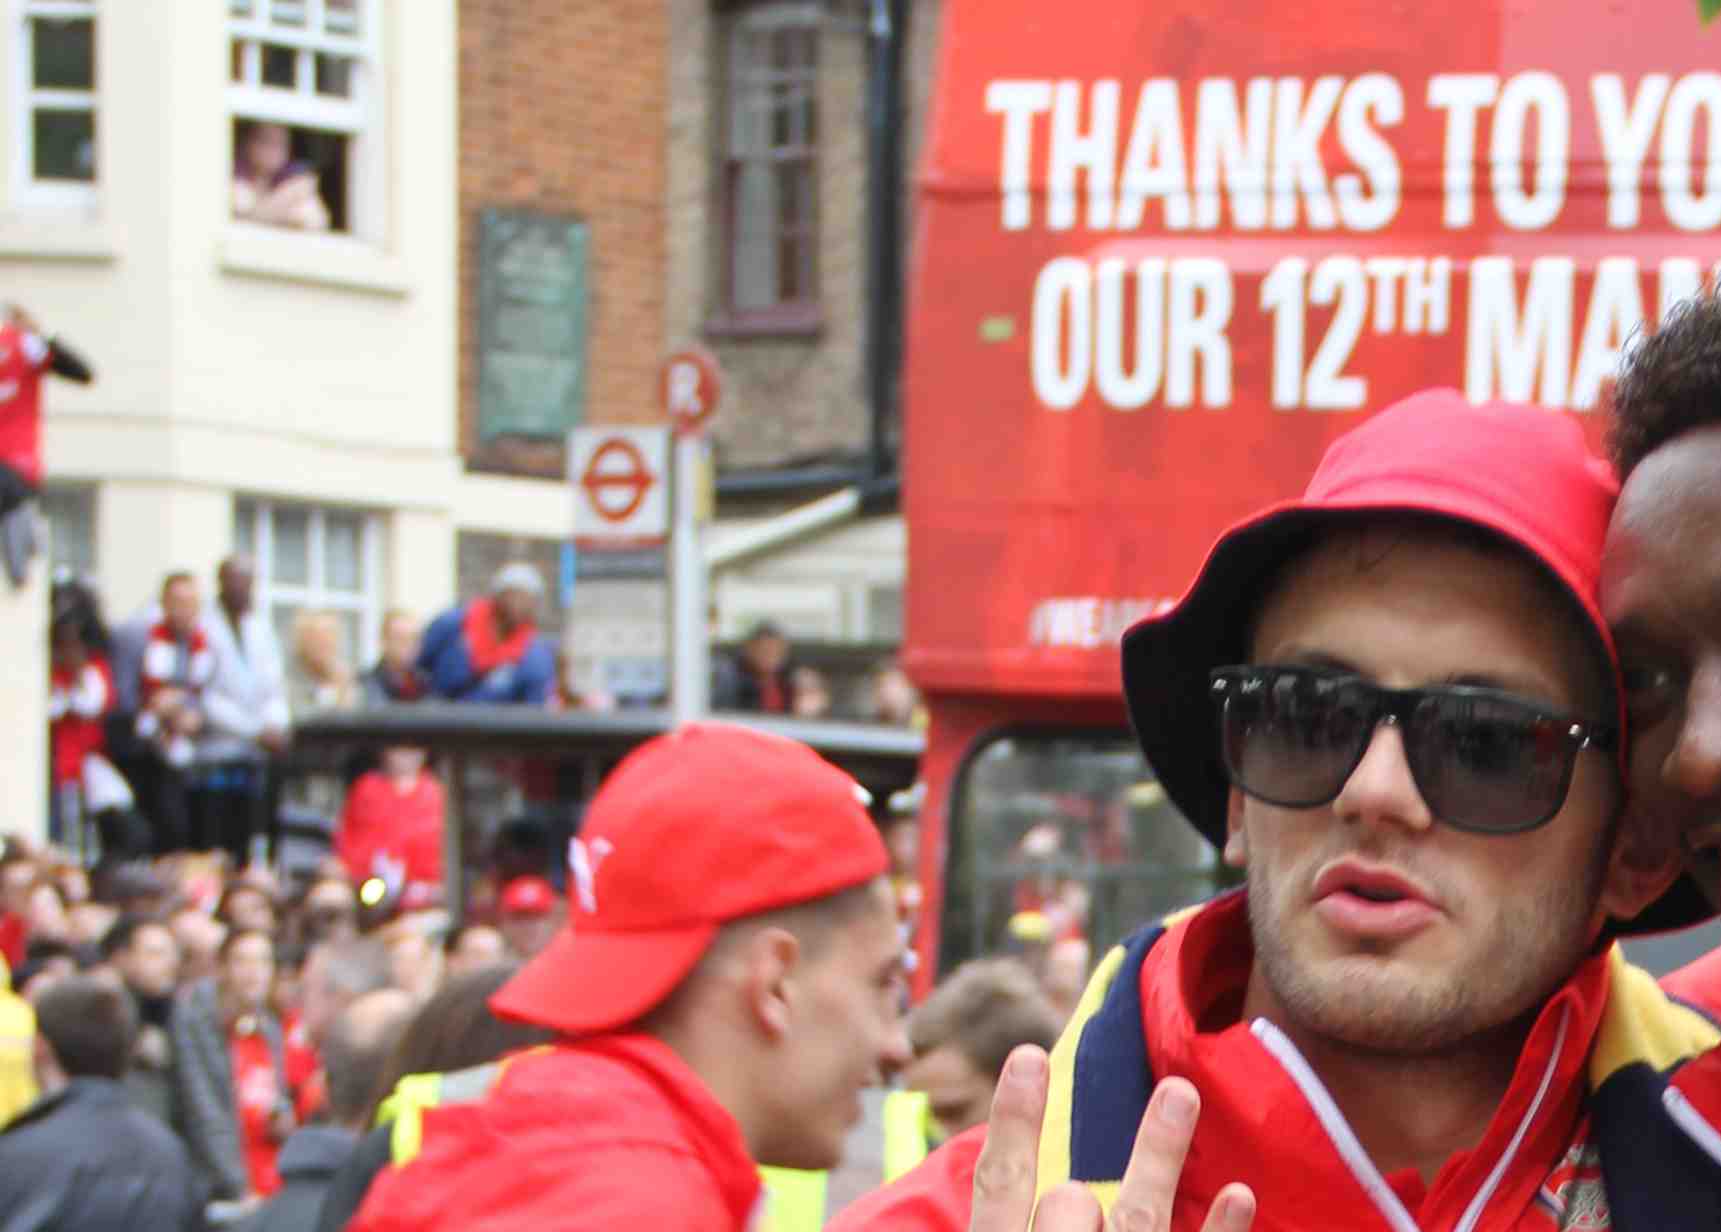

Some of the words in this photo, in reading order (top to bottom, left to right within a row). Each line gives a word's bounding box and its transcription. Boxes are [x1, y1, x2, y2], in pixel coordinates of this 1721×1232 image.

[986, 75, 1403, 232] THANKS
[1428, 73, 1570, 230] TO
[1030, 258, 1233, 409] OUR
[1261, 257, 1450, 411] 12TH
